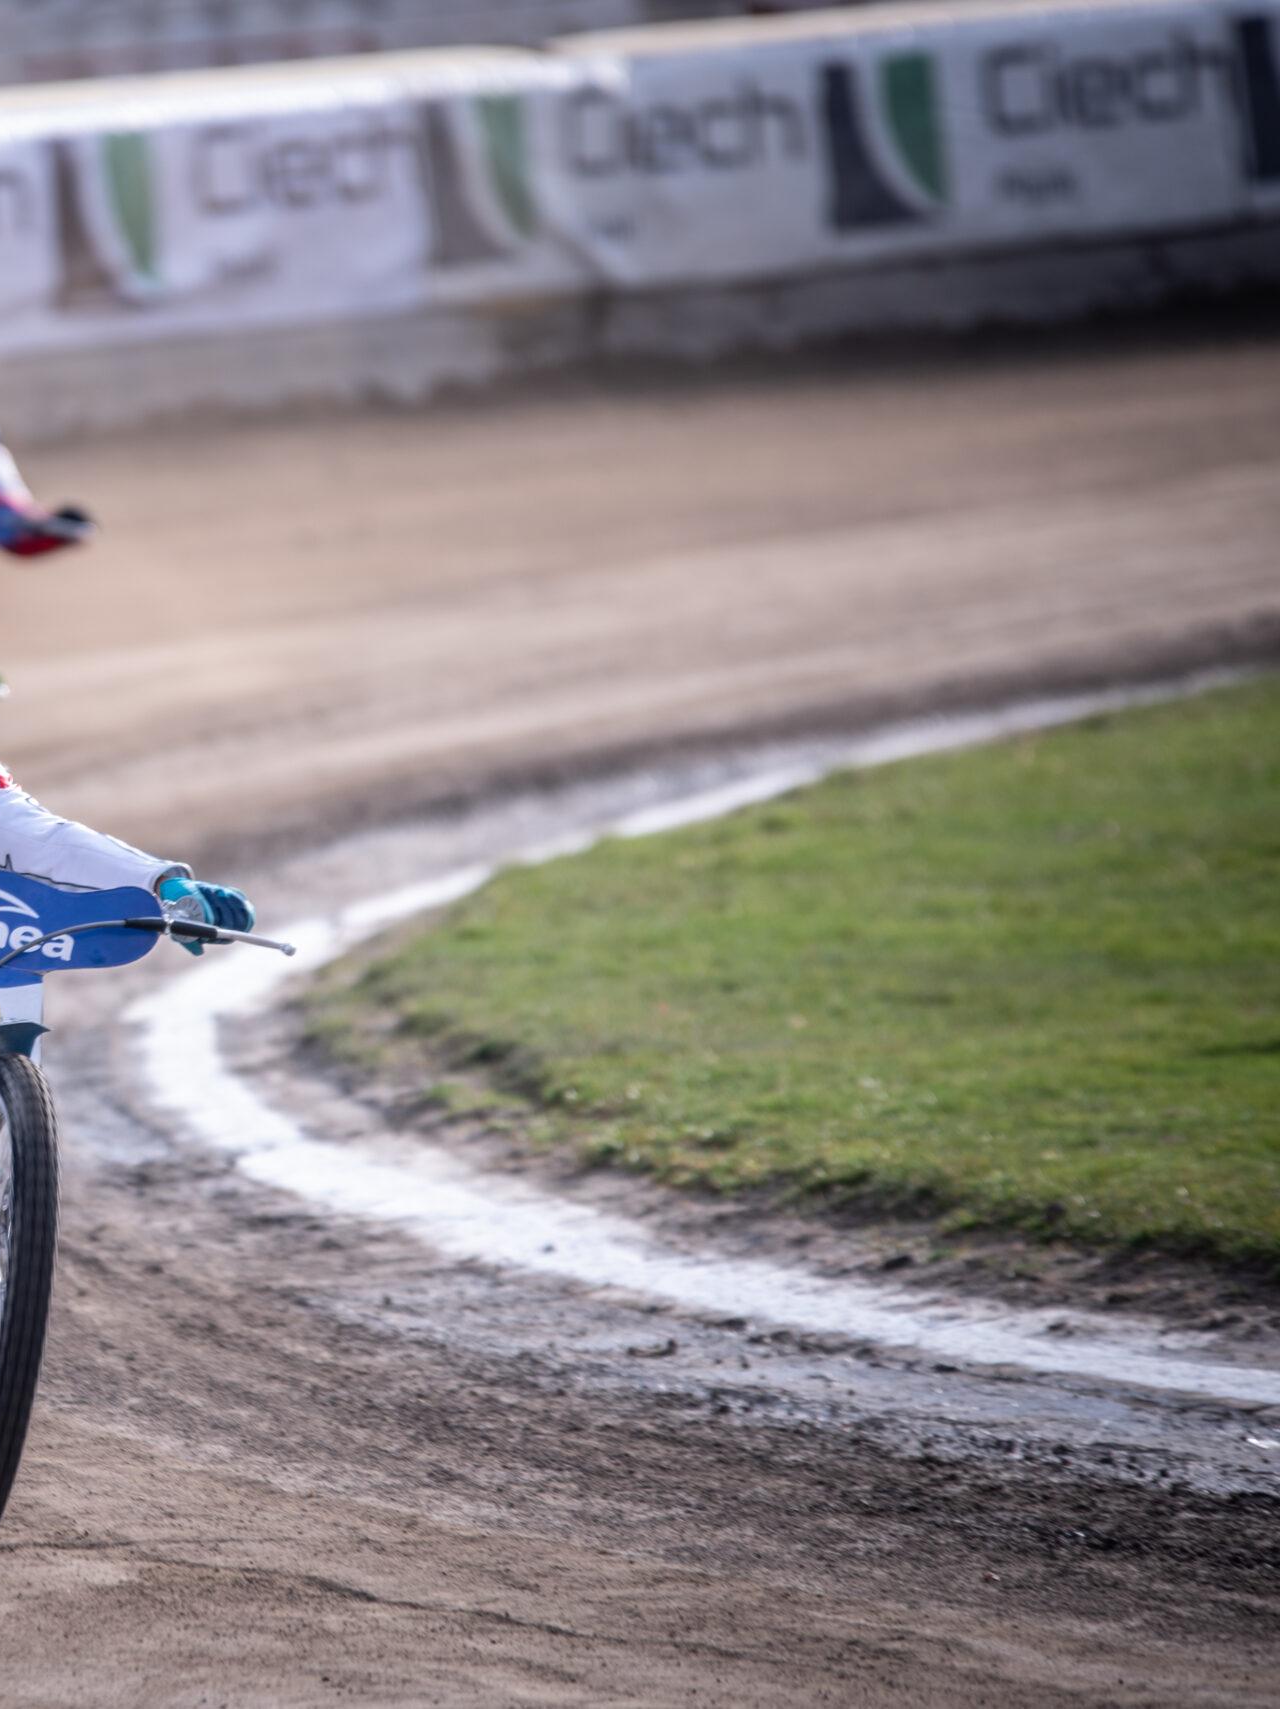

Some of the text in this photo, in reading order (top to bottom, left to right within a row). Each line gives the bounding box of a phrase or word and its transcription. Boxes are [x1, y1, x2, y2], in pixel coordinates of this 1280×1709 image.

[564, 80, 807, 177] Ciech
[984, 28, 1238, 136] Ciech
[192, 108, 426, 212] Ciech
